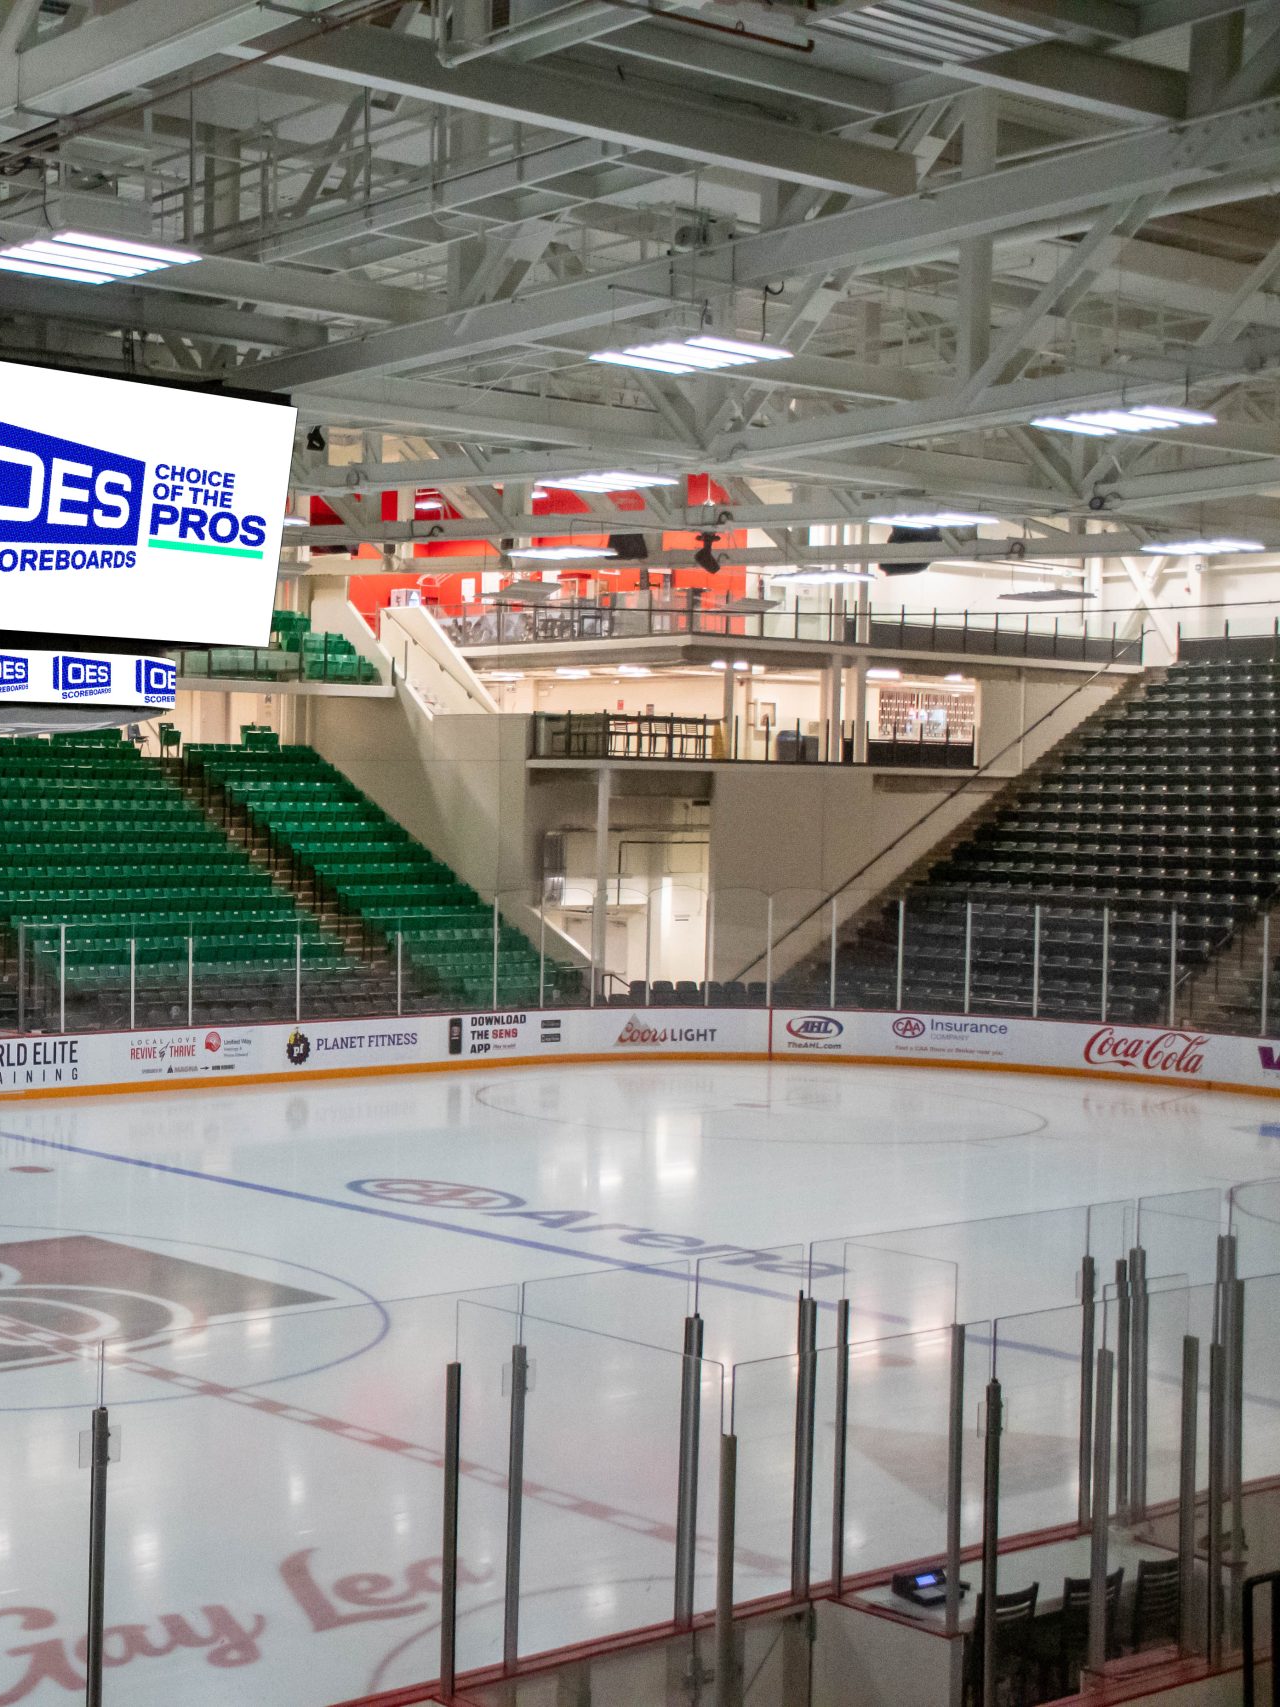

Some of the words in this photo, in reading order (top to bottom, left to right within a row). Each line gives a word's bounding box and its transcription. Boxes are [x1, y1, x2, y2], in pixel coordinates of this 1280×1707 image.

[155, 464, 235, 488] CHOICE
[153, 483, 183, 502] OF
[189, 487, 233, 509] THE
[149, 504, 266, 547] PROS
[67, 663, 109, 684] OES
[61, 688, 112, 700] SCOREBOARDS
[470, 1014, 527, 1027] DOWNLOAD
[798, 1020, 833, 1034] AHL
[895, 1019, 921, 1035] CAA
[930, 1018, 1008, 1034] Insurance
[470, 1029, 490, 1041] THE
[491, 1028, 518, 1039] SENS
[618, 1022, 668, 1043] Coors
[670, 1028, 718, 1042] LIGHT
[130, 1039, 165, 1047] LOCAL
[171, 1036, 197, 1044] LOVE
[316, 1036, 365, 1051] PLANET
[368, 1032, 418, 1048] FITNESS
[470, 1043, 491, 1054] APP
[787, 1041, 842, 1050] TheAHL.com
[1083, 1027, 1211, 1073] Coca-Cola
[33, 1041, 79, 1066] ELITE
[130, 1046, 158, 1060] REVIVE
[169, 1045, 196, 1058] THRIVE
[375, 1178, 495, 1209] CAA
[479, 1208, 851, 1281] Arena
[279, 1546, 496, 1634] Lea
